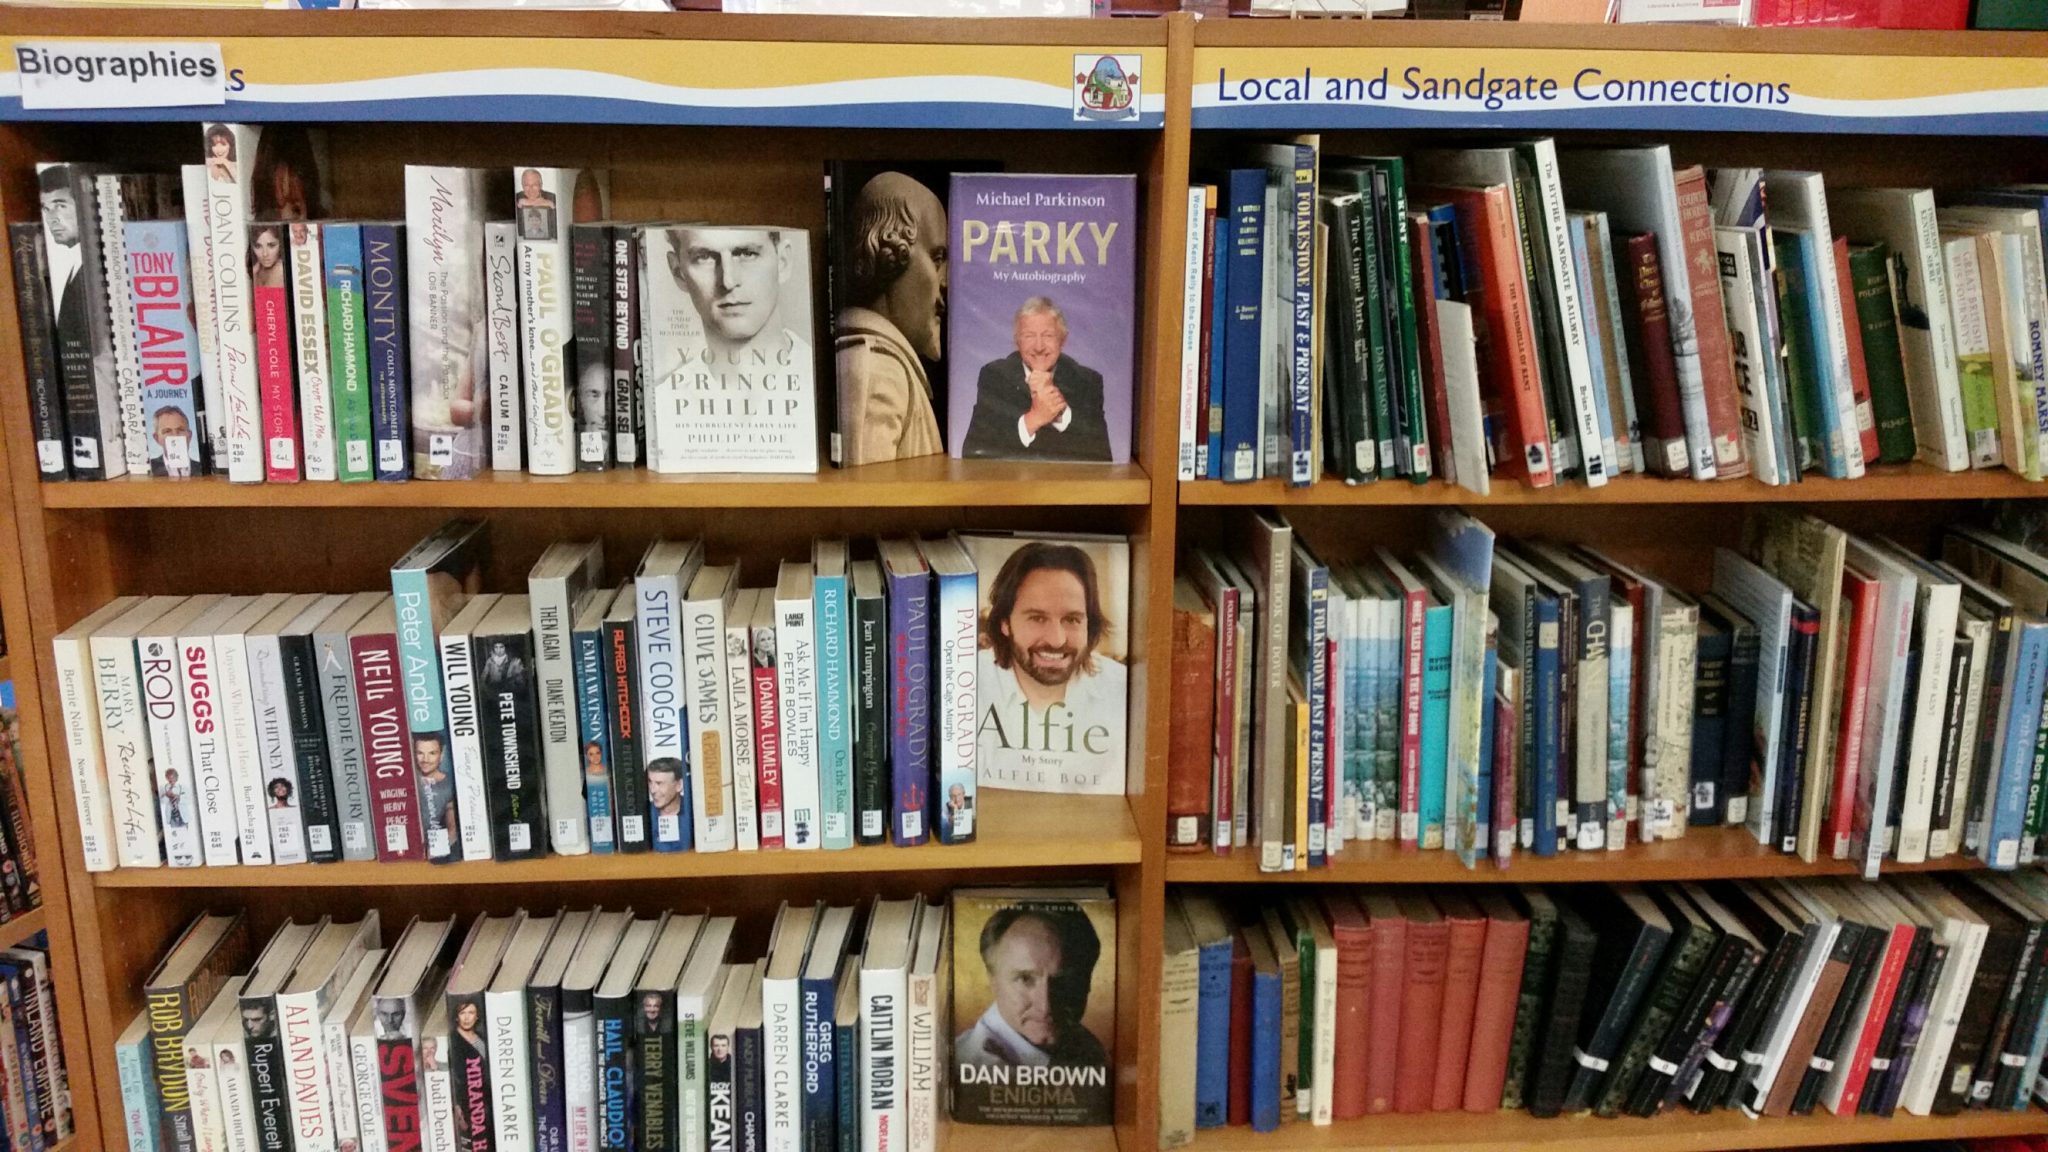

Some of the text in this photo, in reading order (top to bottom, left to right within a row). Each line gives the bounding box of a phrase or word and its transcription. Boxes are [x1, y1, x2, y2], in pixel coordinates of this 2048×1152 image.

[16, 47, 217, 83] Biographies
[1218, 66, 1792, 110] Local and Sandgate Connections
[212, 193, 235, 246] JOAN
[423, 175, 454, 266] Marilyn
[976, 192, 1106, 207] Michael Parkinson
[1350, 215, 1361, 241] The
[1364, 214, 1376, 252] KENT
[1548, 183, 1561, 223] HYTHE
[131, 252, 176, 275] TONY
[962, 219, 1119, 266] PARKY
[1556, 233, 1572, 291] SANDGATE
[218, 252, 241, 334] COLLINS
[339, 280, 354, 330] RICHARD
[370, 240, 396, 348] MONTY
[615, 239, 629, 350] ONE STEP BEYOND
[993, 271, 1087, 284] My Autobiography
[1295, 191, 1311, 413] FOLKESTONE PAST & PRESENT
[1366, 255, 1379, 300] DOWNS
[133, 274, 191, 388] BLAIR
[266, 300, 281, 378] CHERYL COLE
[296, 249, 320, 375] DAVID ESSEX
[1353, 296, 1365, 331] Ports
[1565, 295, 1580, 347] RAILWAY
[343, 331, 358, 392] HAMMOND
[676, 347, 793, 366] YOUNG
[1511, 300, 1532, 392] WINDMILLS KENT
[2030, 319, 2045, 382] ROMNEY
[121, 367, 136, 401] CARL
[155, 388, 190, 399] JOURNEY
[499, 374, 510, 419] CALUM
[540, 327, 565, 446] O'GRADY
[616, 377, 630, 416] GRAM
[670, 373, 801, 392] PRINCE
[675, 398, 799, 416] PHILIP
[1579, 385, 1591, 412] Brian
[687, 433, 741, 444] PHILIP
[1584, 413, 1593, 436] Hart
[1273, 583, 1283, 618] BOOK
[399, 591, 431, 723] Peter Andre
[539, 605, 568, 744] THEN AGAIN DIANE KEATON
[645, 589, 677, 749] STEVE COOGAN
[695, 613, 719, 725] CLIVE JAMES
[824, 588, 841, 741] RICHARD HAMMOND
[862, 620, 876, 709] Jean Trumpington
[943, 639, 956, 665] Open
[1271, 645, 1283, 689] DOVER
[1312, 607, 1326, 690] FOLKESTONE
[63, 668, 82, 746] Bernie Nolan
[98, 657, 125, 735] BERRY
[143, 658, 176, 721] ROD
[360, 649, 405, 779] NEIL YOUNG
[445, 641, 475, 738] WILL YOUNG
[498, 692, 516, 723] PETE
[582, 639, 603, 741] EMMA WATSON
[612, 629, 632, 739] ALFRED HITCHCOCK
[731, 666, 751, 766] LAILA MORSE
[783, 652, 799, 757] PETER BOWLES
[796, 639, 814, 767] Ask Me Happy
[907, 595, 928, 770] PAUL O'GRADY
[957, 607, 976, 770] PAUL O'GRADY
[1312, 691, 1325, 726] PAST
[186, 646, 221, 815] SUGGS That Close
[263, 706, 284, 770] WHITNEY
[330, 674, 364, 822] FREDDIE MERCURY
[503, 723, 521, 790] TOWNSHEND
[756, 676, 779, 787] JOANNA LUMLEY
[977, 699, 1110, 755] Alfie
[983, 768, 1101, 786] ALFIE BOE
[1022, 754, 1063, 768] My Story
[1310, 746, 1324, 800] PRESENT
[2032, 754, 2045, 780] BOB
[383, 802, 407, 813] HEAVY
[2026, 784, 2040, 826] OGLEY
[148, 992, 192, 1112] ROB BRYDON
[684, 1013, 695, 1039] STEVE
[805, 991, 819, 1094] RUTHERFORD
[819, 1021, 832, 1063] GREG
[870, 994, 894, 1110] CAITLIN MORAN
[912, 1012, 932, 1091] WILLIAM
[251, 1043, 283, 1150] Rupert Everett
[286, 1004, 324, 1140] ALAN DAVIES
[353, 1043, 376, 1137] GEORGE COLE
[377, 1043, 421, 1152] SVEN
[466, 1057, 487, 1136] MIRANDA
[496, 1015, 519, 1142] DARREN CLARKE
[644, 1036, 665, 1150] TERRY VENABLES
[773, 1003, 789, 1128] DARREN CLARKE
[960, 1063, 1106, 1087] DAN BROWN
[989, 1085, 1077, 1105] ENIGMA
[430, 1076, 451, 1152] Judi Dench
[606, 1066, 625, 1149] CLAUDIO!
